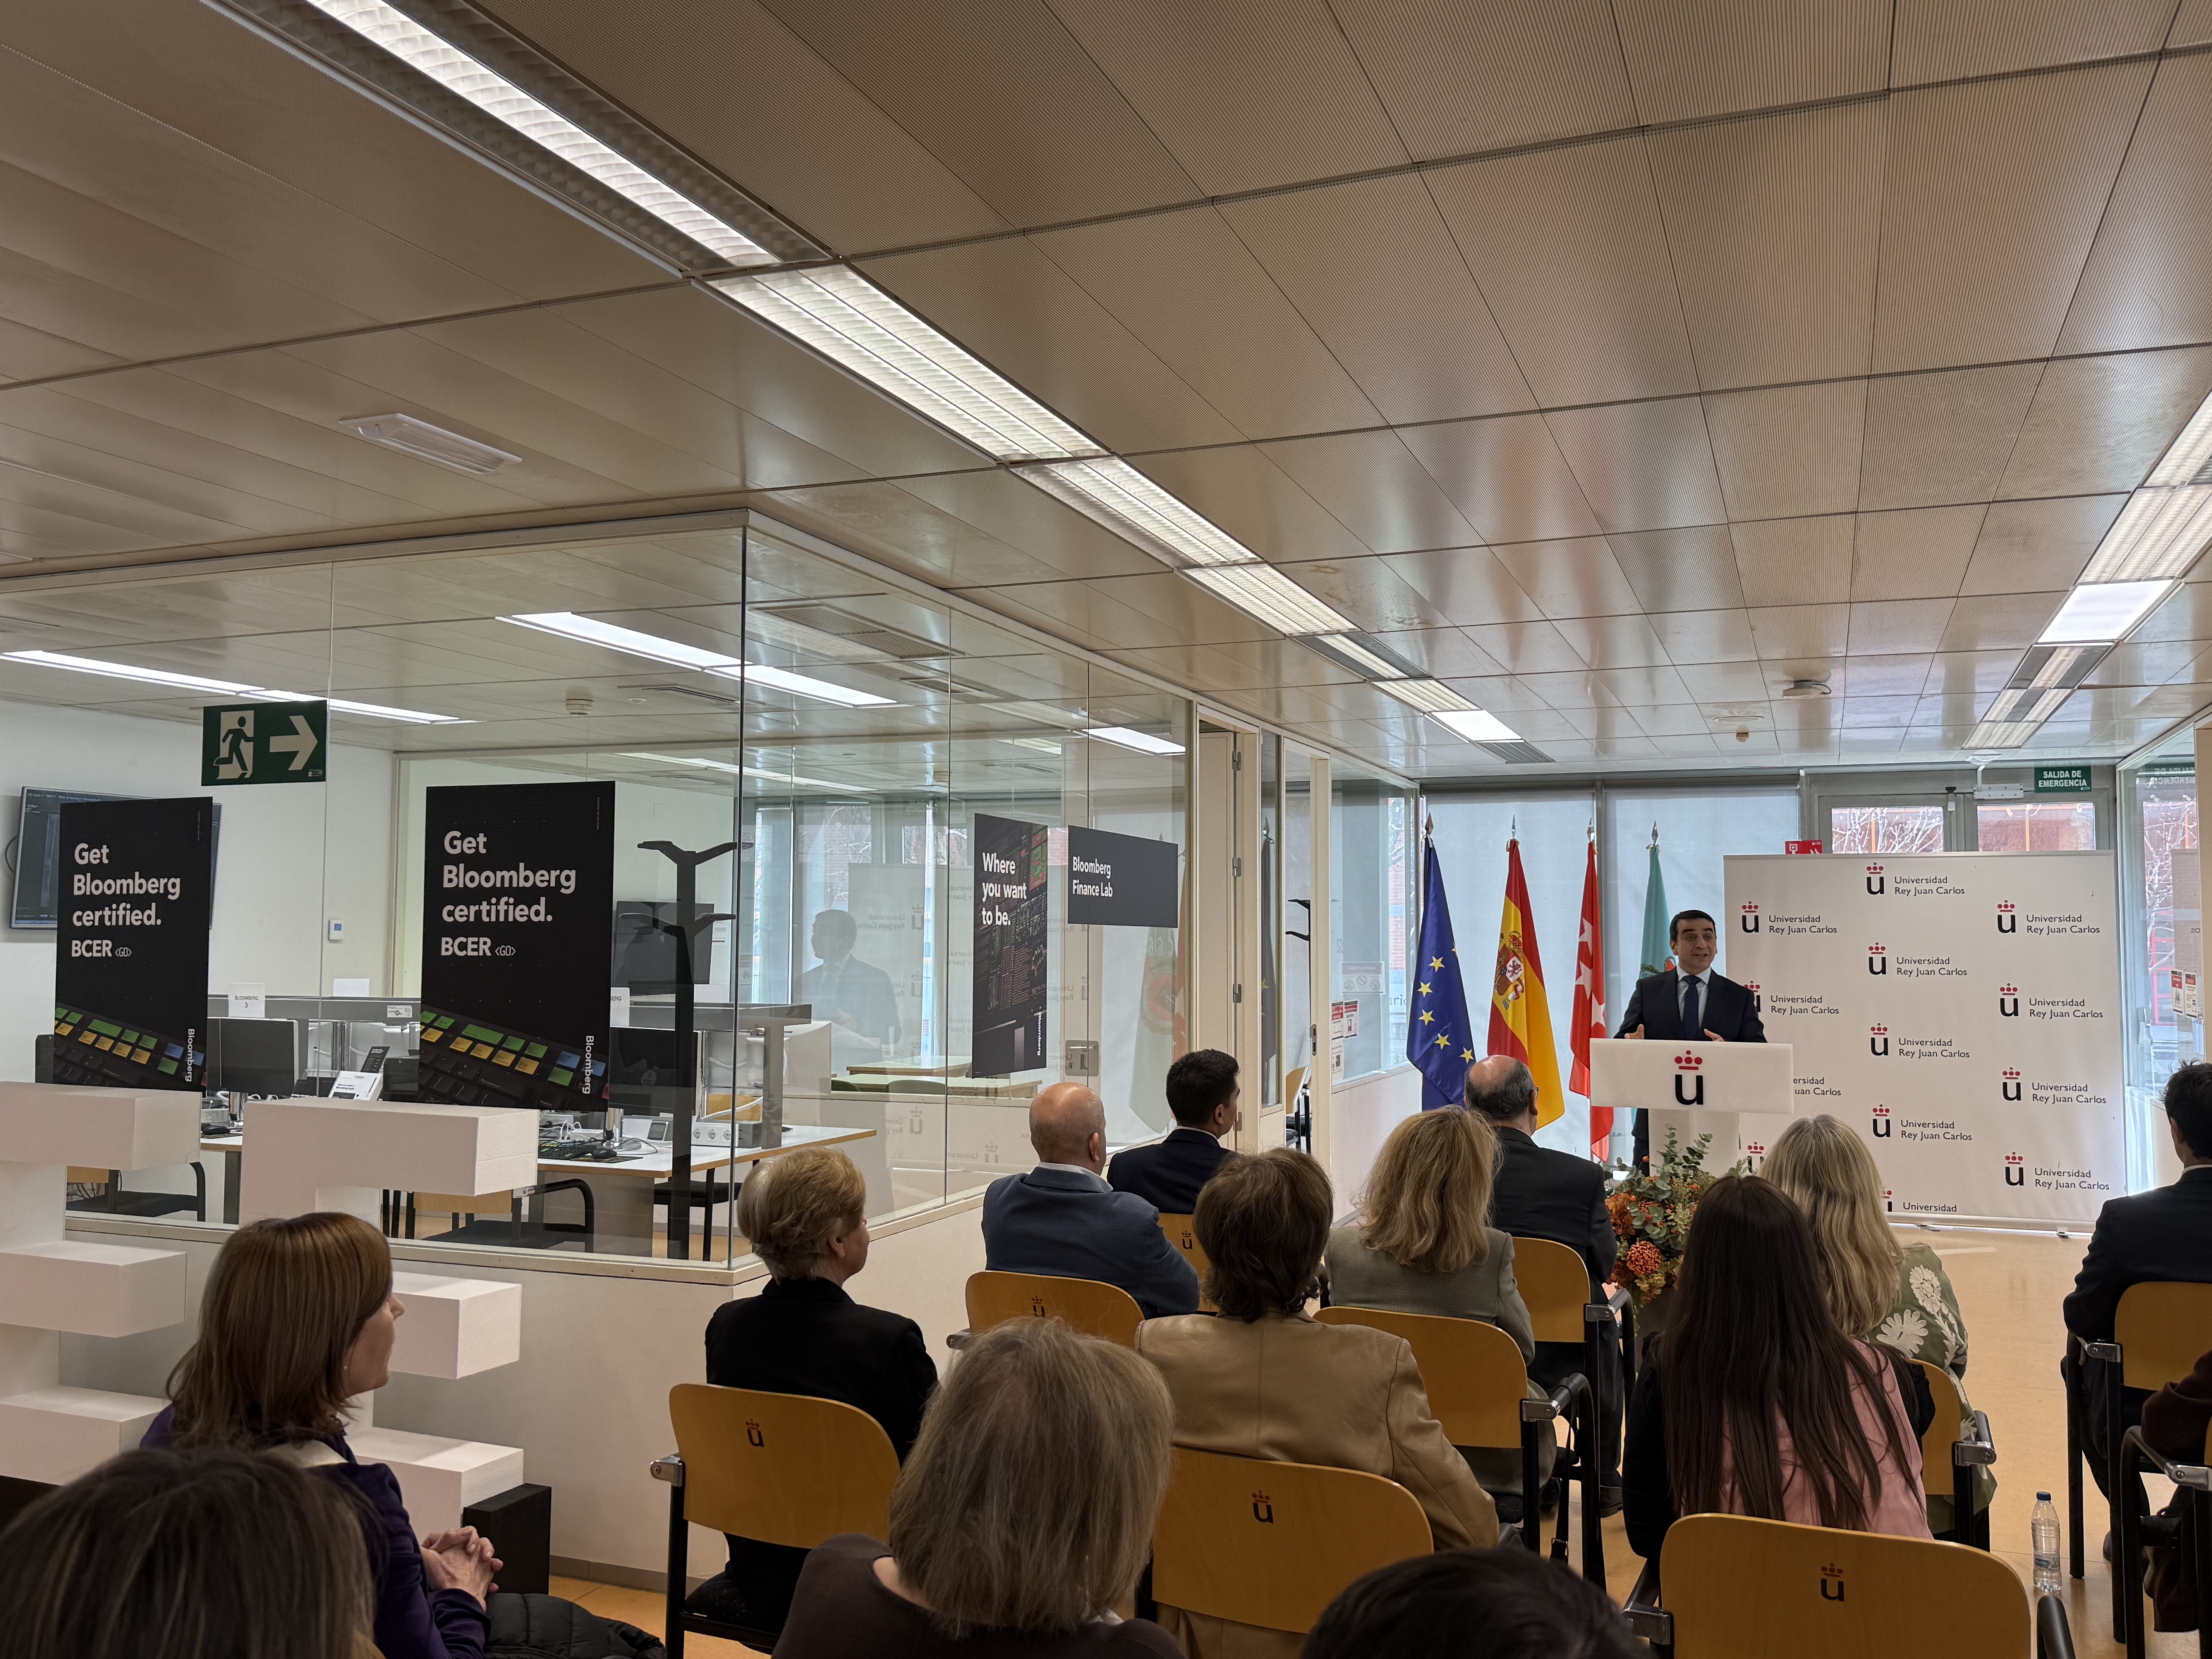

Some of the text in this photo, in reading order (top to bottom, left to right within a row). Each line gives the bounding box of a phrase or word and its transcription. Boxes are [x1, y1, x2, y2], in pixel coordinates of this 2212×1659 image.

[2039, 779, 2087, 787] EMERGENCIA
[444, 831, 487, 854] Get
[74, 843, 109, 865] Get
[982, 852, 1015, 875] Where
[1073, 856, 1111, 879] Bloomberg
[443, 862, 576, 894] Bloomberg
[1894, 876, 1948, 884] Universidad
[73, 871, 180, 900] Bloomberg
[1073, 879, 1113, 897] Finance Lab
[982, 882, 1027, 902] you want
[1895, 887, 1911, 896] Rey
[1913, 886, 1933, 896] Juan
[72, 902, 161, 926] certified.
[442, 896, 553, 922] certified.
[982, 905, 1011, 926] to be.
[1769, 925, 1785, 935] Rey
[1787, 926, 1806, 935] Juan
[2027, 925, 2100, 935] Rey Juan Carlos
[71, 939, 112, 957] BCER
[441, 937, 491, 956] BCER
[1897, 957, 1950, 965] Universidad
[1897, 967, 1967, 977] Rey Juan Carlos
[1771, 995, 1822, 1003] Universidad
[2029, 998, 2085, 1006] Universidad
[1771, 1005, 1839, 1015] Rey Juan Carlos
[2030, 1009, 2103, 1019] Rey Juan Carlos
[1899, 1037, 1952, 1046] Universidad
[185, 1029, 195, 1082] Bloomberg
[1899, 1048, 1970, 1059] Rey Juan Carlos
[582, 1036, 594, 1094] Bloomberg
[1793, 1077, 1824, 1085] ersidad
[1813, 1087, 1841, 1096] Carlos
[2032, 1082, 2088, 1092] Universidad
[2032, 1094, 2106, 1104] Rey Juan Carlos
[1901, 1119, 1954, 1129] Universidad
[1901, 1130, 1972, 1141] Rey Juan Carlos
[2035, 1168, 2091, 1178] Universidad
[2035, 1179, 2109, 1190] Rey Juan Carlos
[1903, 1202, 1957, 1212] Universidad
